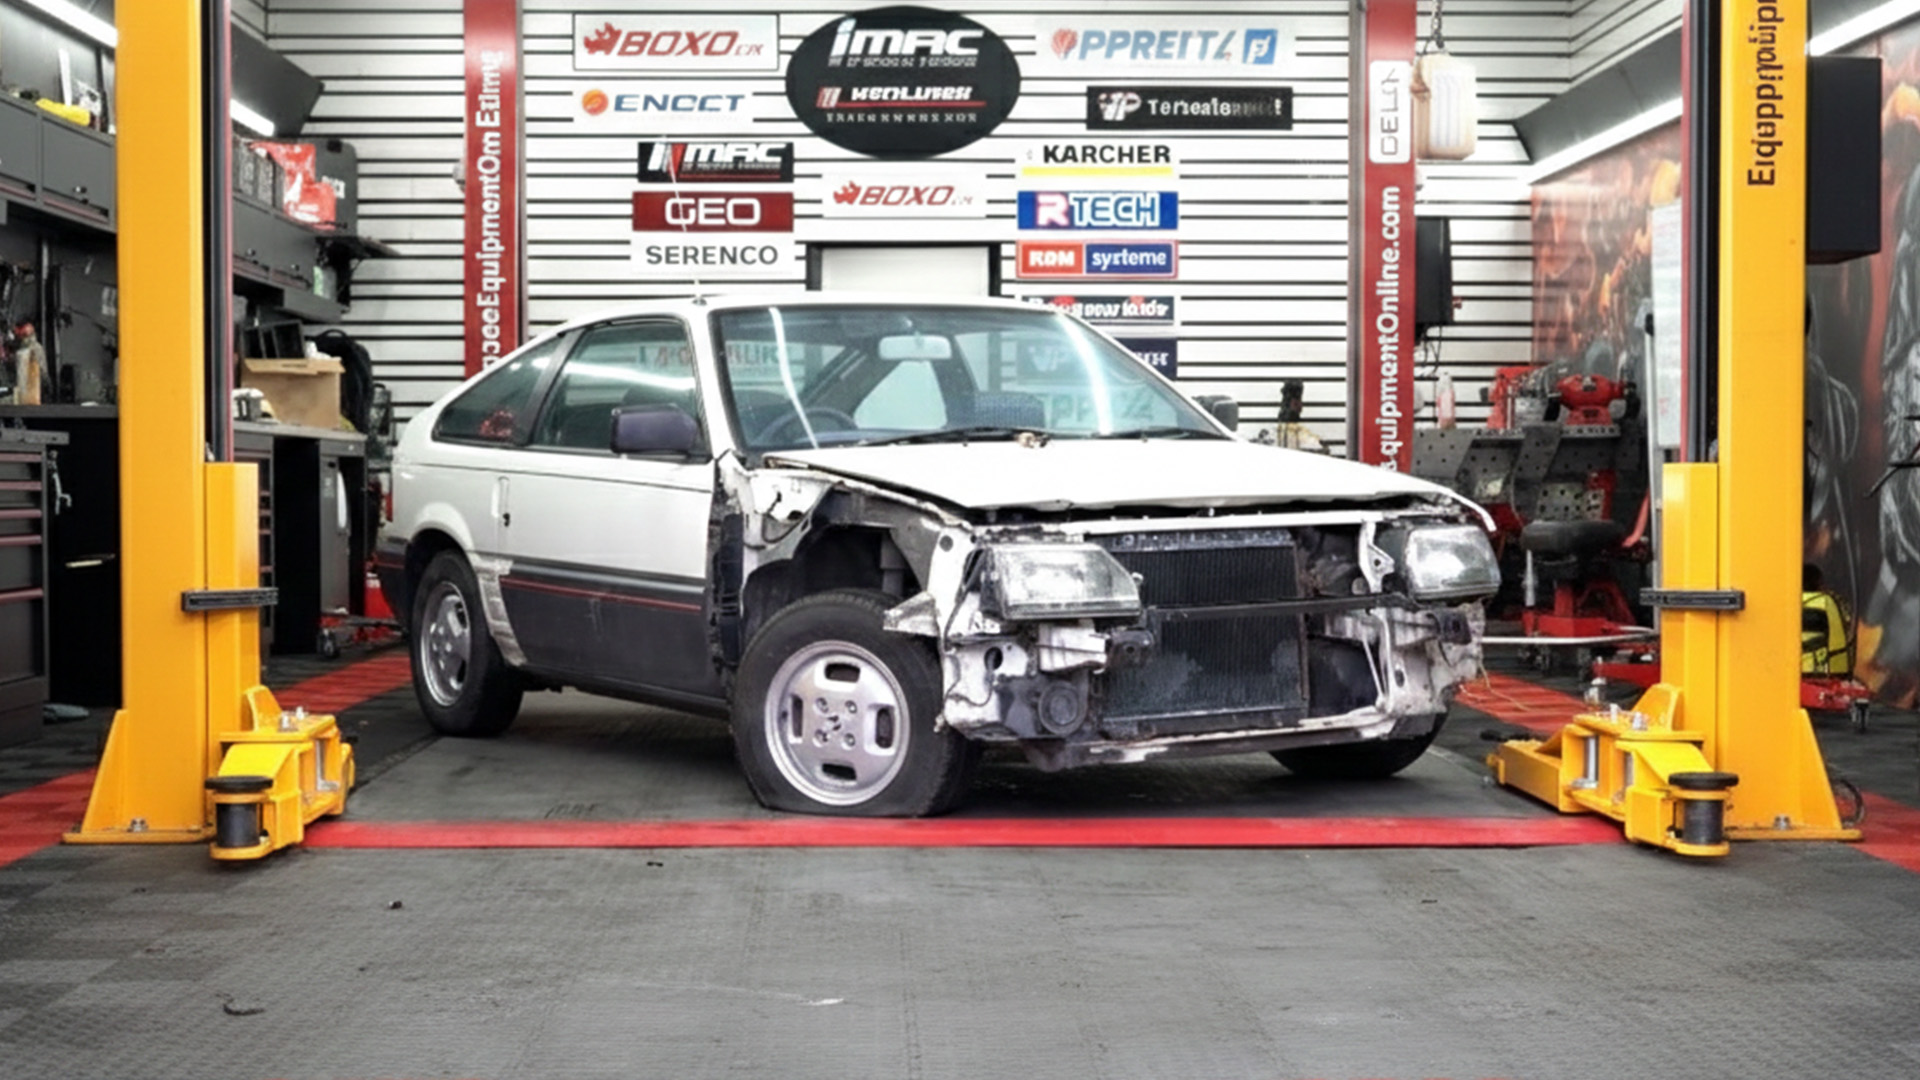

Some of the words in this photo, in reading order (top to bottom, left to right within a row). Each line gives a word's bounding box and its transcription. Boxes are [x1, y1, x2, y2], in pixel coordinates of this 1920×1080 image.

[617, 31, 739, 56] BOXO
[1043, 145, 1171, 164] KARCHER
[859, 185, 955, 206] BOXO
[665, 198, 761, 226] GEO
[645, 245, 778, 265] SERENCO
